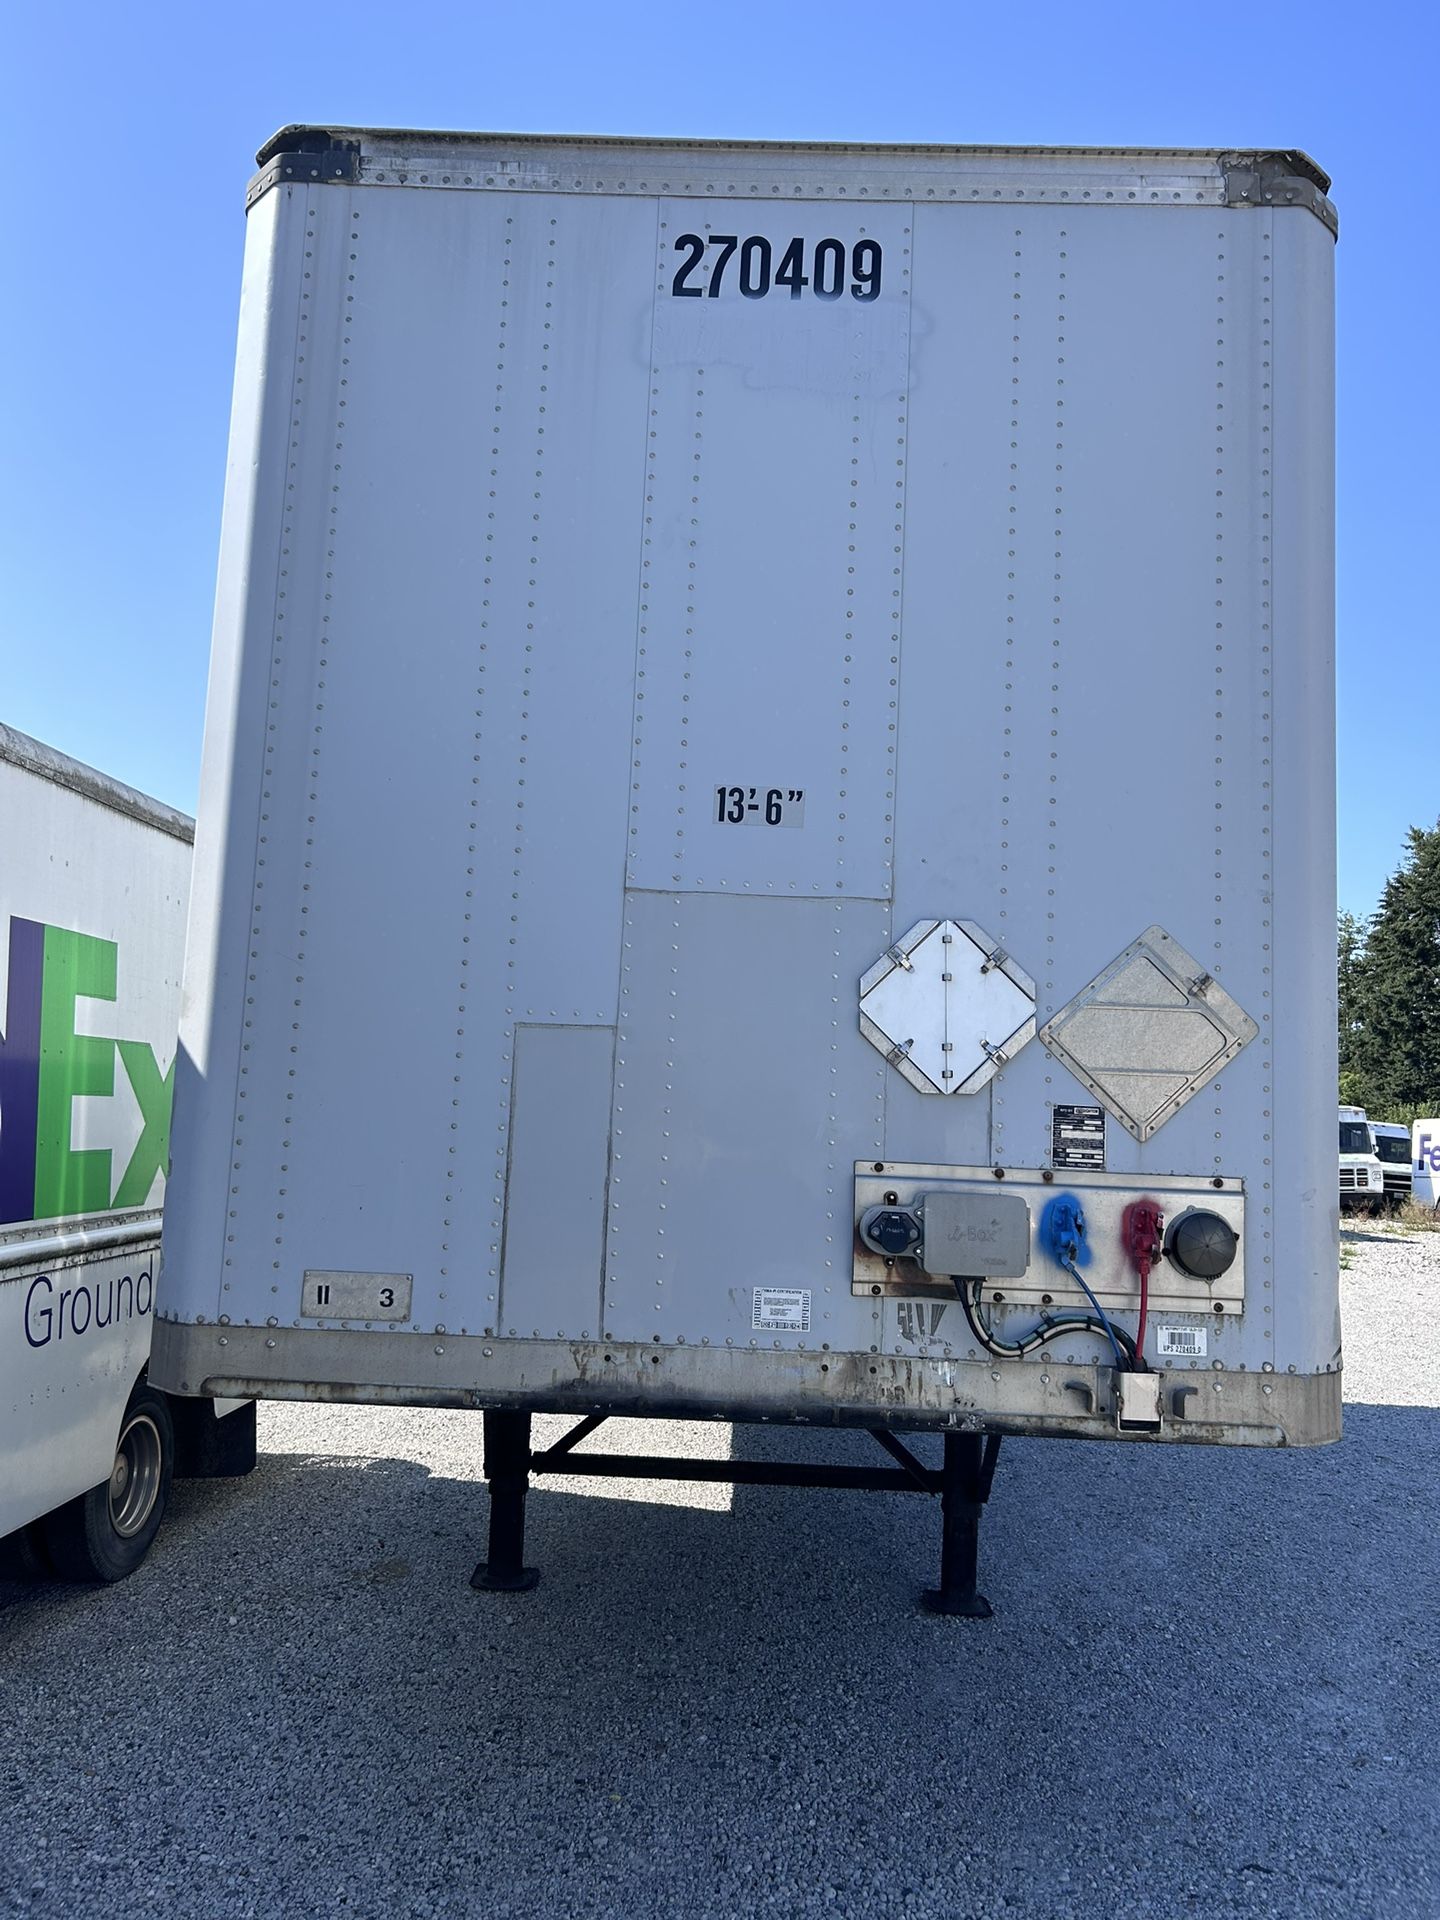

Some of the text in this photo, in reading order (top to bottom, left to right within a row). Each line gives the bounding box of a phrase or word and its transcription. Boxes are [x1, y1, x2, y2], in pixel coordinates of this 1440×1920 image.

[672, 233, 882, 303] 270409
[24, 1254, 152, 1348] Ground
[380, 1288, 394, 1308] 3
